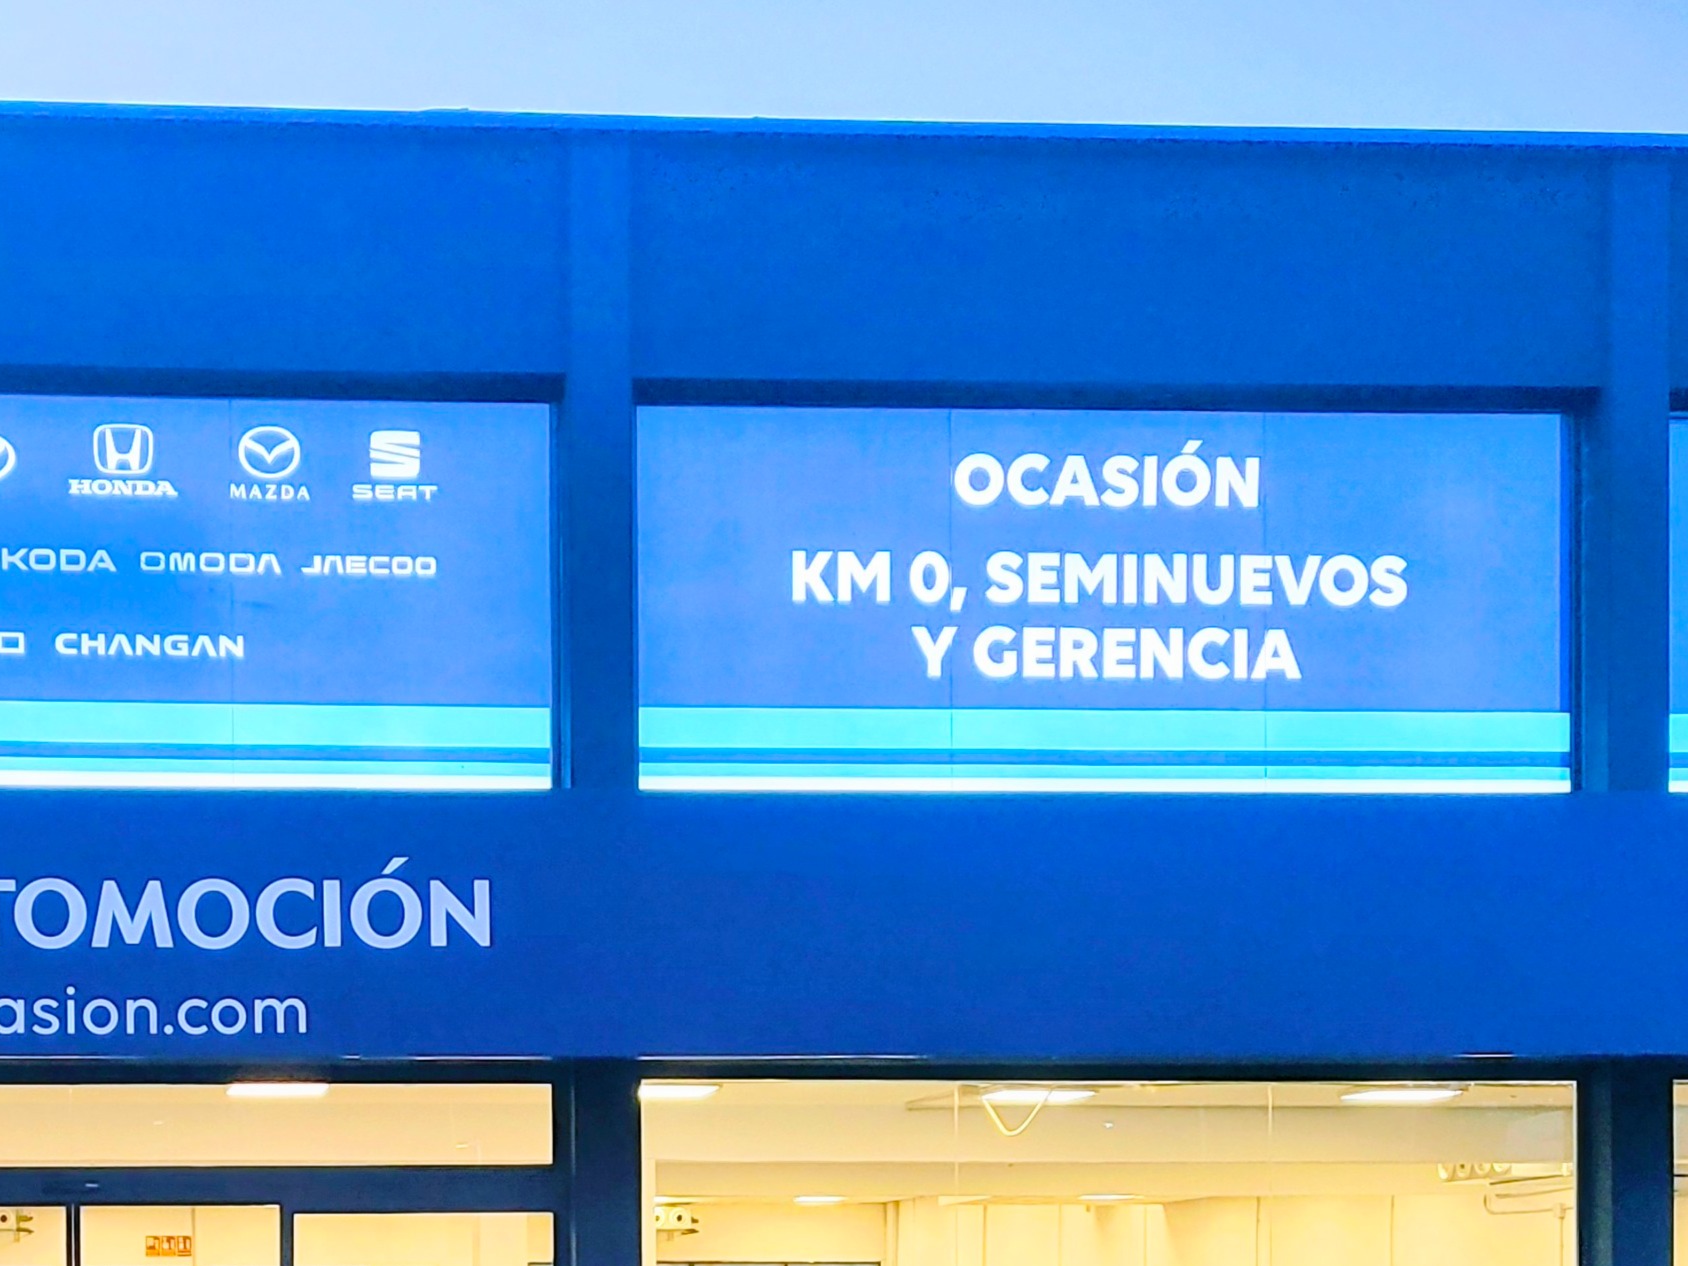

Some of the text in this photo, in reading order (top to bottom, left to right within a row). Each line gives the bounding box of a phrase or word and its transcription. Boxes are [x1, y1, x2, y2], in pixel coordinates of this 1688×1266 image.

[953, 438, 1260, 509] OCASIÓN
[68, 478, 178, 498] HONDA
[229, 482, 310, 502] MAZDA
[352, 484, 438, 502] SEAT
[140, 551, 283, 577] OMODA
[301, 555, 437, 578] JAECOO
[792, 550, 1408, 612] KM 0, SEMINUEVOS
[54, 633, 245, 660] CHANGAN
[911, 625, 1302, 680] Y GERENCIA
